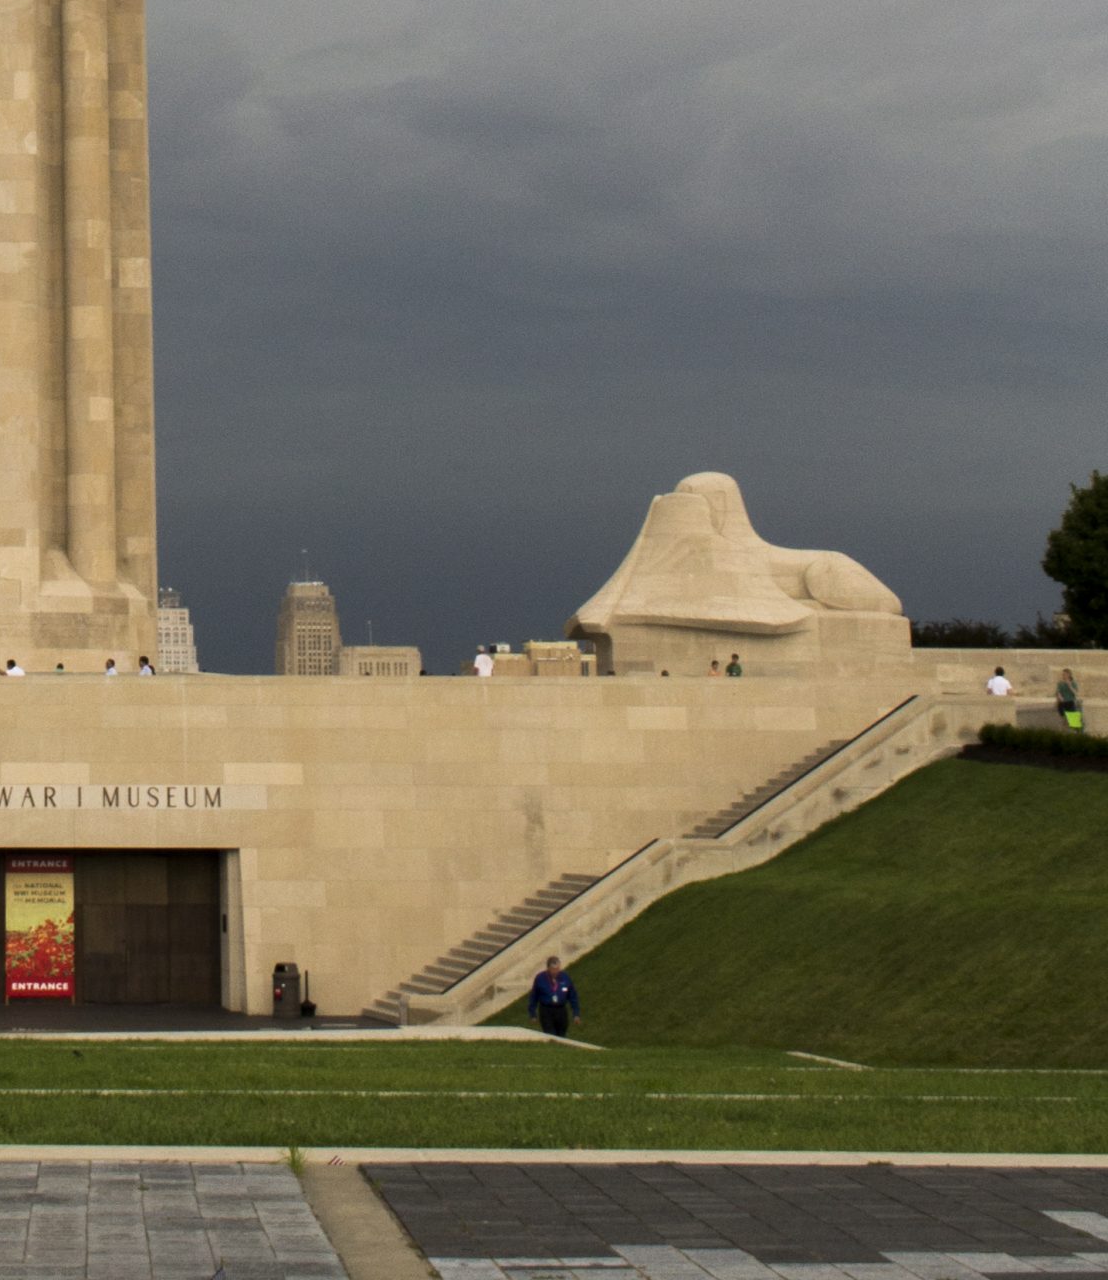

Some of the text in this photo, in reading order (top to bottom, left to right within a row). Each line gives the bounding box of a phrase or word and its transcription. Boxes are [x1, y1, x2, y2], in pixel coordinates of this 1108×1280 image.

[76, 786, 83, 808] I
[102, 786, 222, 808] MUSEUM
[11, 982, 69, 991] ENTRANCE
